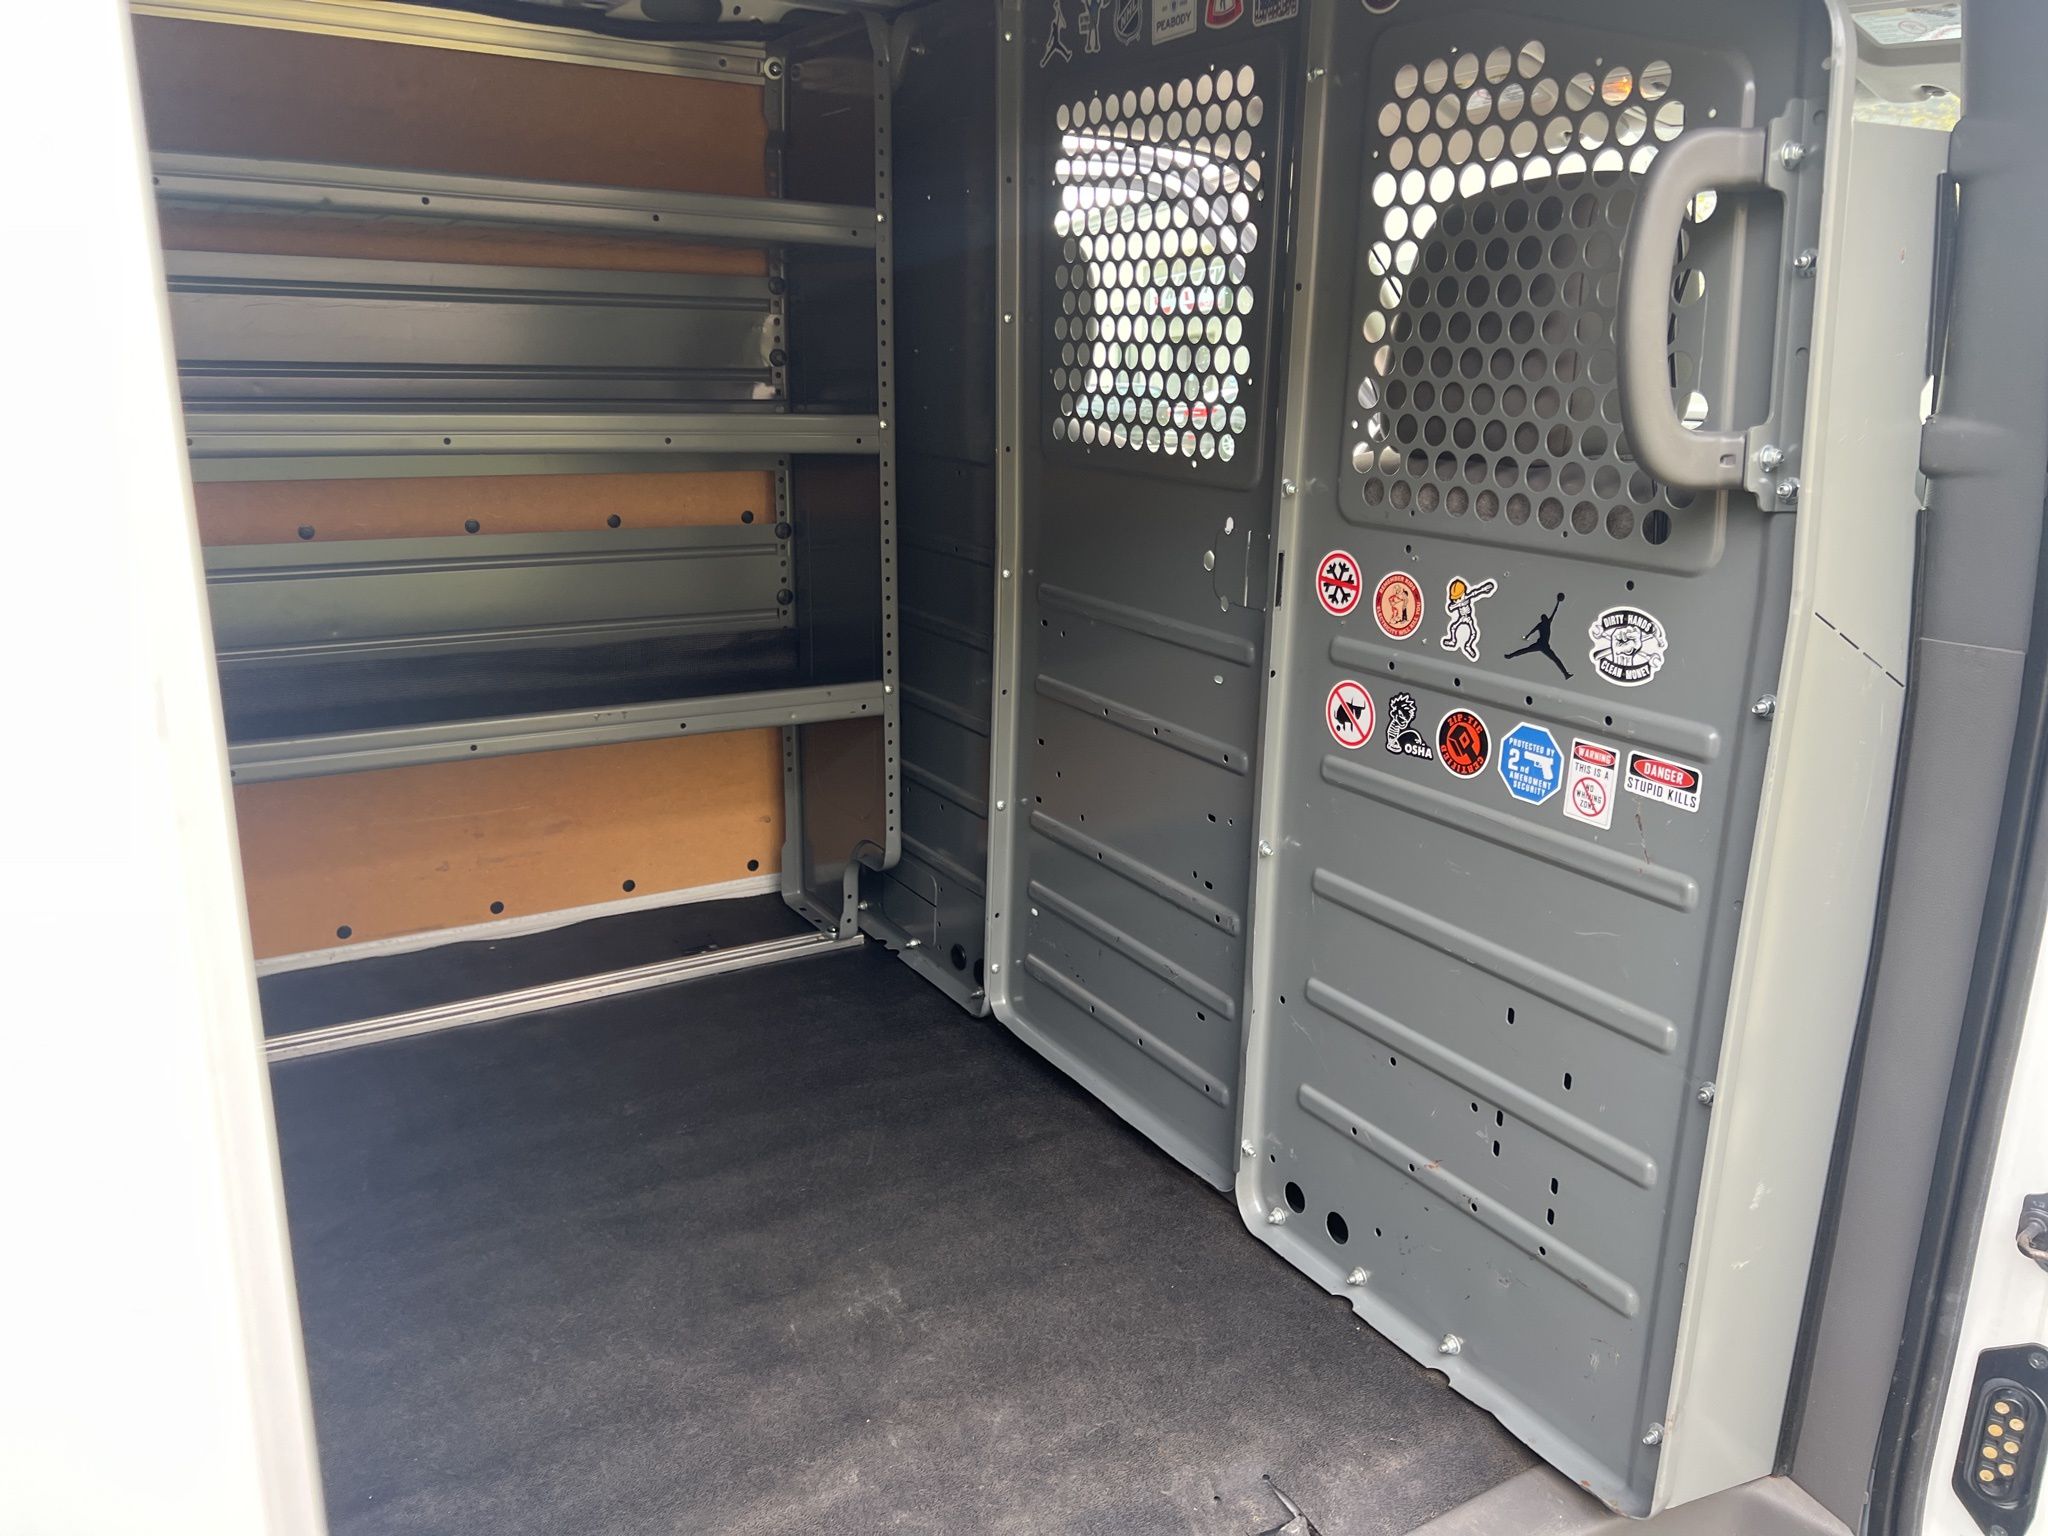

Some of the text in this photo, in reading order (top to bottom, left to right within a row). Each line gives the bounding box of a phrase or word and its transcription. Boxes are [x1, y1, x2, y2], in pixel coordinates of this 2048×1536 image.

[1156, 10, 1192, 32] PEABODY
[1603, 614, 1652, 632] DIRTY HANDS
[1600, 660, 1650, 680] CLEAN MONEY
[1447, 713, 1483, 734] ZIP-TIE
[1404, 743, 1433, 759] OSHA
[1508, 737, 1555, 757] PROTECTED BY
[1578, 747, 1613, 765] WARNING
[1440, 744, 1485, 774] CERTIFIED
[1508, 770, 1552, 791] AMENDMENT
[1575, 762, 1609, 780] THIS IS A
[1643, 762, 1684, 785] DANGER
[1512, 779, 1546, 798] SECURITY
[1626, 776, 1697, 809] STUPID KILLS
